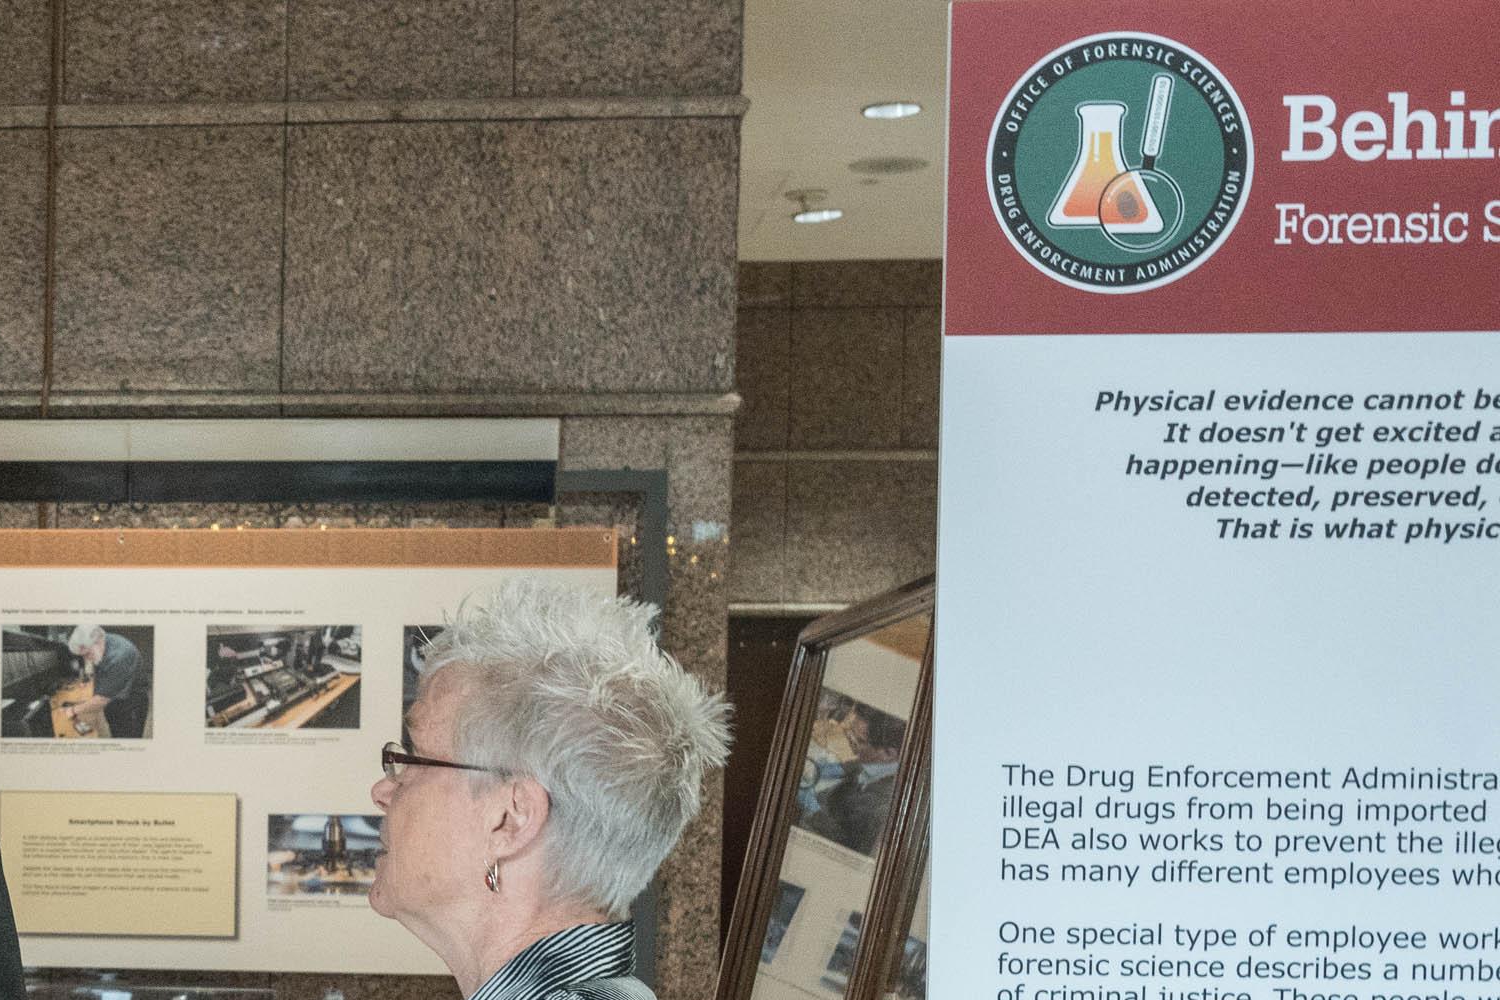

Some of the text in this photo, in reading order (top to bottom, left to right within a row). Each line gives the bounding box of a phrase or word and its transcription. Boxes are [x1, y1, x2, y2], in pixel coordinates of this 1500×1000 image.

[1006, 75, 1049, 132] OFFICE
[1053, 56, 1074, 76] OF
[1083, 43, 1175, 66] FORENSIC
[1180, 60, 1239, 133] SCIENCES
[998, 170, 1240, 282] DRUG ENFORCEMENT ADMINISTRATION
[1274, 203, 1469, 245] Forensic
[1094, 389, 1216, 417] Physical
[1223, 388, 1355, 412] evidence
[1363, 389, 1466, 411] cannot
[1162, 422, 1192, 444] It
[1198, 420, 1309, 444] doesn't
[1314, 421, 1365, 449] get
[1372, 420, 1482, 443] excited
[1365, 452, 1467, 481] people
[1185, 484, 1321, 512] detected,
[1330, 484, 1488, 513] preserved,
[1216, 517, 1282, 540] That
[1288, 517, 1314, 540] is
[1324, 516, 1399, 540] what
[1001, 763, 1500, 794] The Drug Enforcement Administra
[1002, 794, 1487, 828] illegal drugs from being imported
[1002, 827, 1061, 850] DEA
[1070, 826, 1128, 851] also
[1138, 827, 1224, 852] works
[1234, 829, 1263, 853] to
[1274, 831, 1387, 859] prevent
[1396, 829, 1444, 855] the
[1001, 857, 1050, 882] has
[1061, 863, 1140, 888] many
[1151, 859, 1274, 885] different
[1284, 861, 1440, 891] employees
[998, 920, 1056, 945] One
[1066, 922, 1163, 951] special
[1173, 924, 1237, 952] type
[1248, 923, 1278, 948] of
[1286, 924, 1427, 955] employee
[997, 951, 1500, 983] forensic science describes a numb
